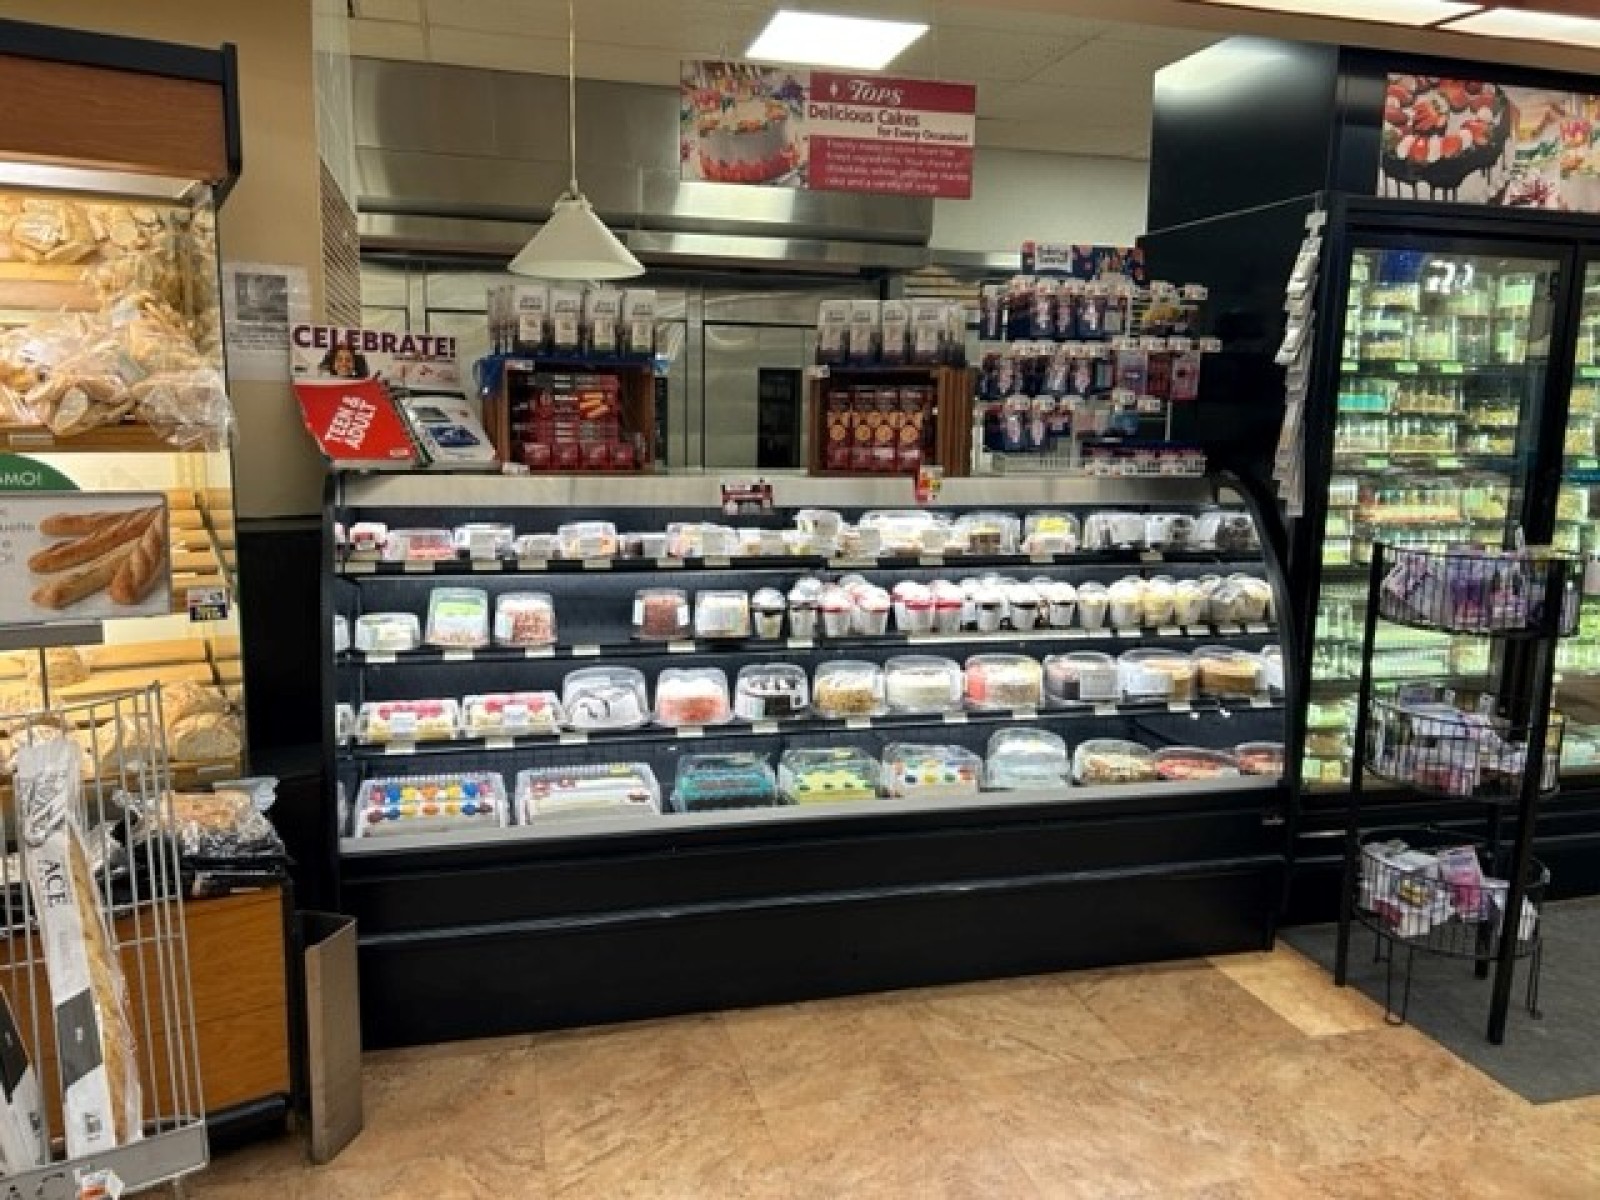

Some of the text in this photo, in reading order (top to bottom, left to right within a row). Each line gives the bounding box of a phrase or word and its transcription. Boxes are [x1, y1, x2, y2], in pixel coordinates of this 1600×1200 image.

[809, 104, 920, 127] Delicious Cakes
[894, 129, 920, 140] Every
[293, 325, 456, 358] CELEBRATE!
[39, 858, 67, 907] ACE
